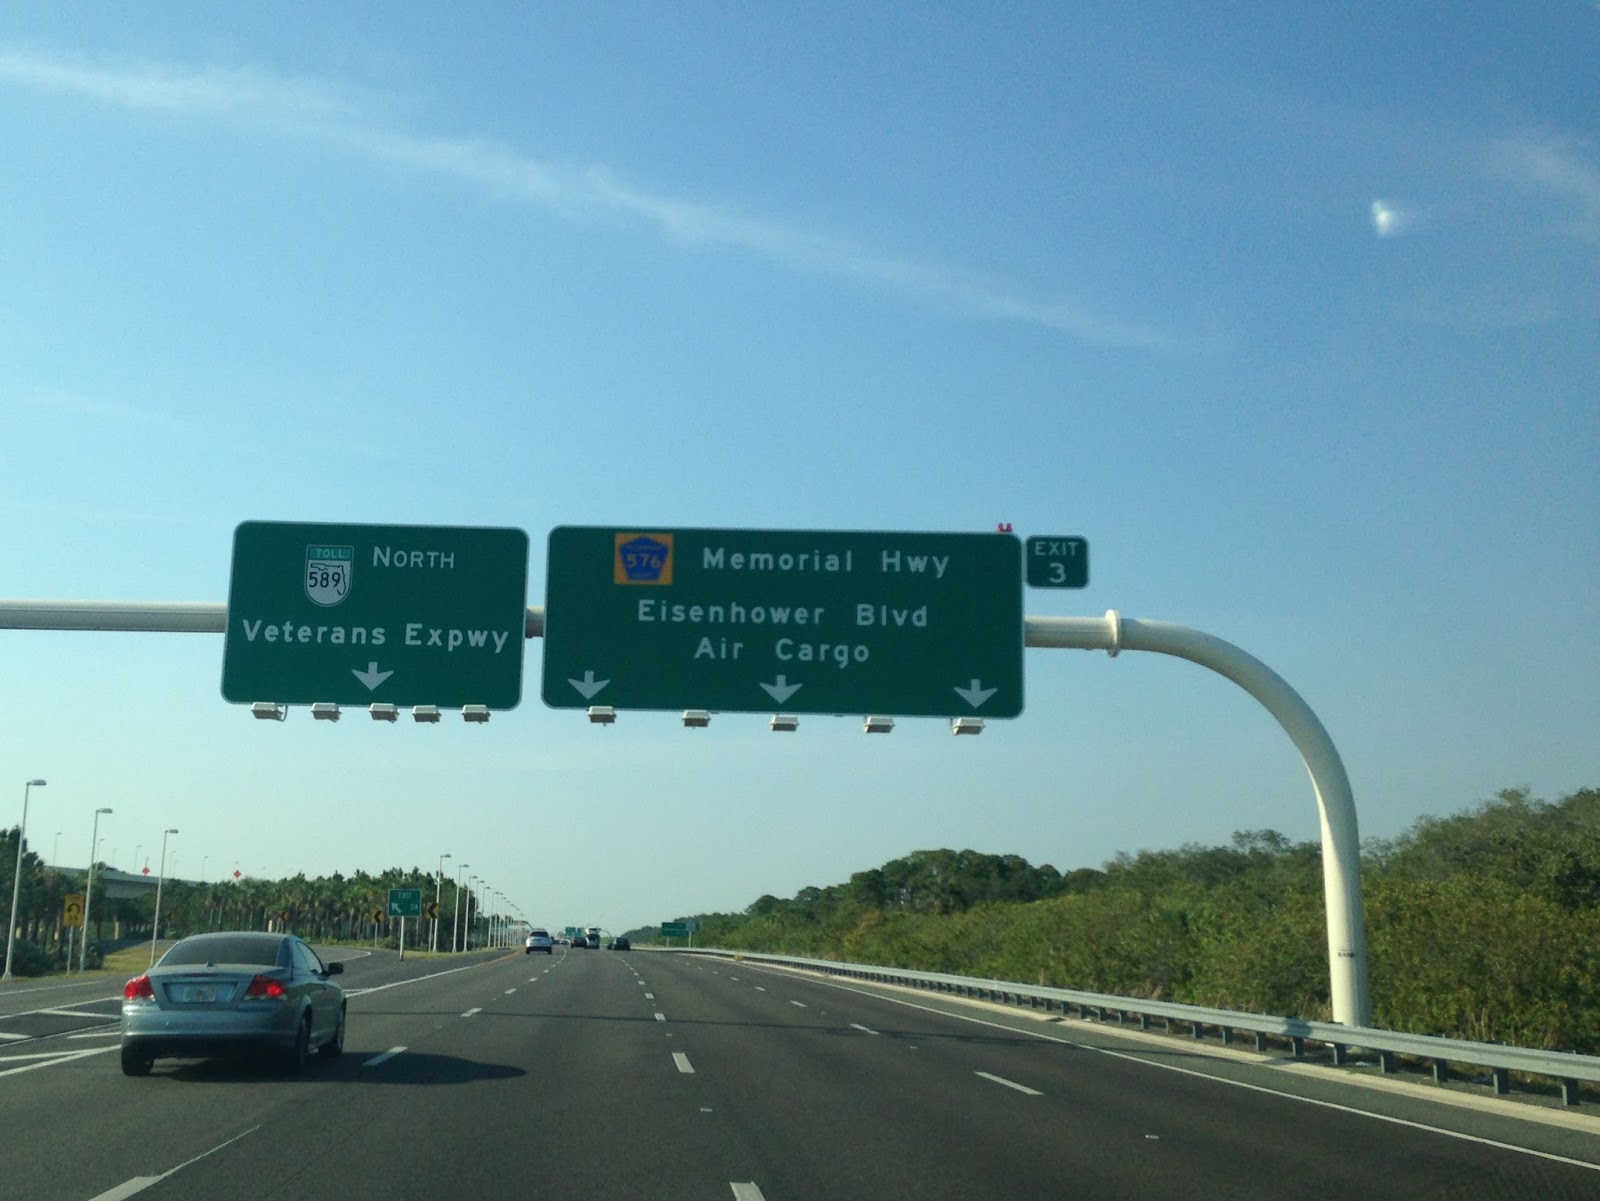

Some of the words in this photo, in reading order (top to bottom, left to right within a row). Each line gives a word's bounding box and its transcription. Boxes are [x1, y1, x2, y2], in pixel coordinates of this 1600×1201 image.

[316, 548, 345, 559] TOLL
[373, 546, 455, 569] NORTH
[1034, 541, 1079, 556] EXIT
[626, 553, 661, 569] 576
[703, 547, 852, 572] Memorial
[882, 550, 949, 579] Hwy
[309, 571, 341, 588] 589
[1049, 562, 1066, 584] 3
[638, 599, 825, 625] Eisenhower
[856, 603, 927, 627] Blvd
[242, 619, 386, 645] Veterans
[405, 623, 509, 654] Expwy
[694, 636, 744, 659] Air
[775, 637, 869, 669] Cargo
